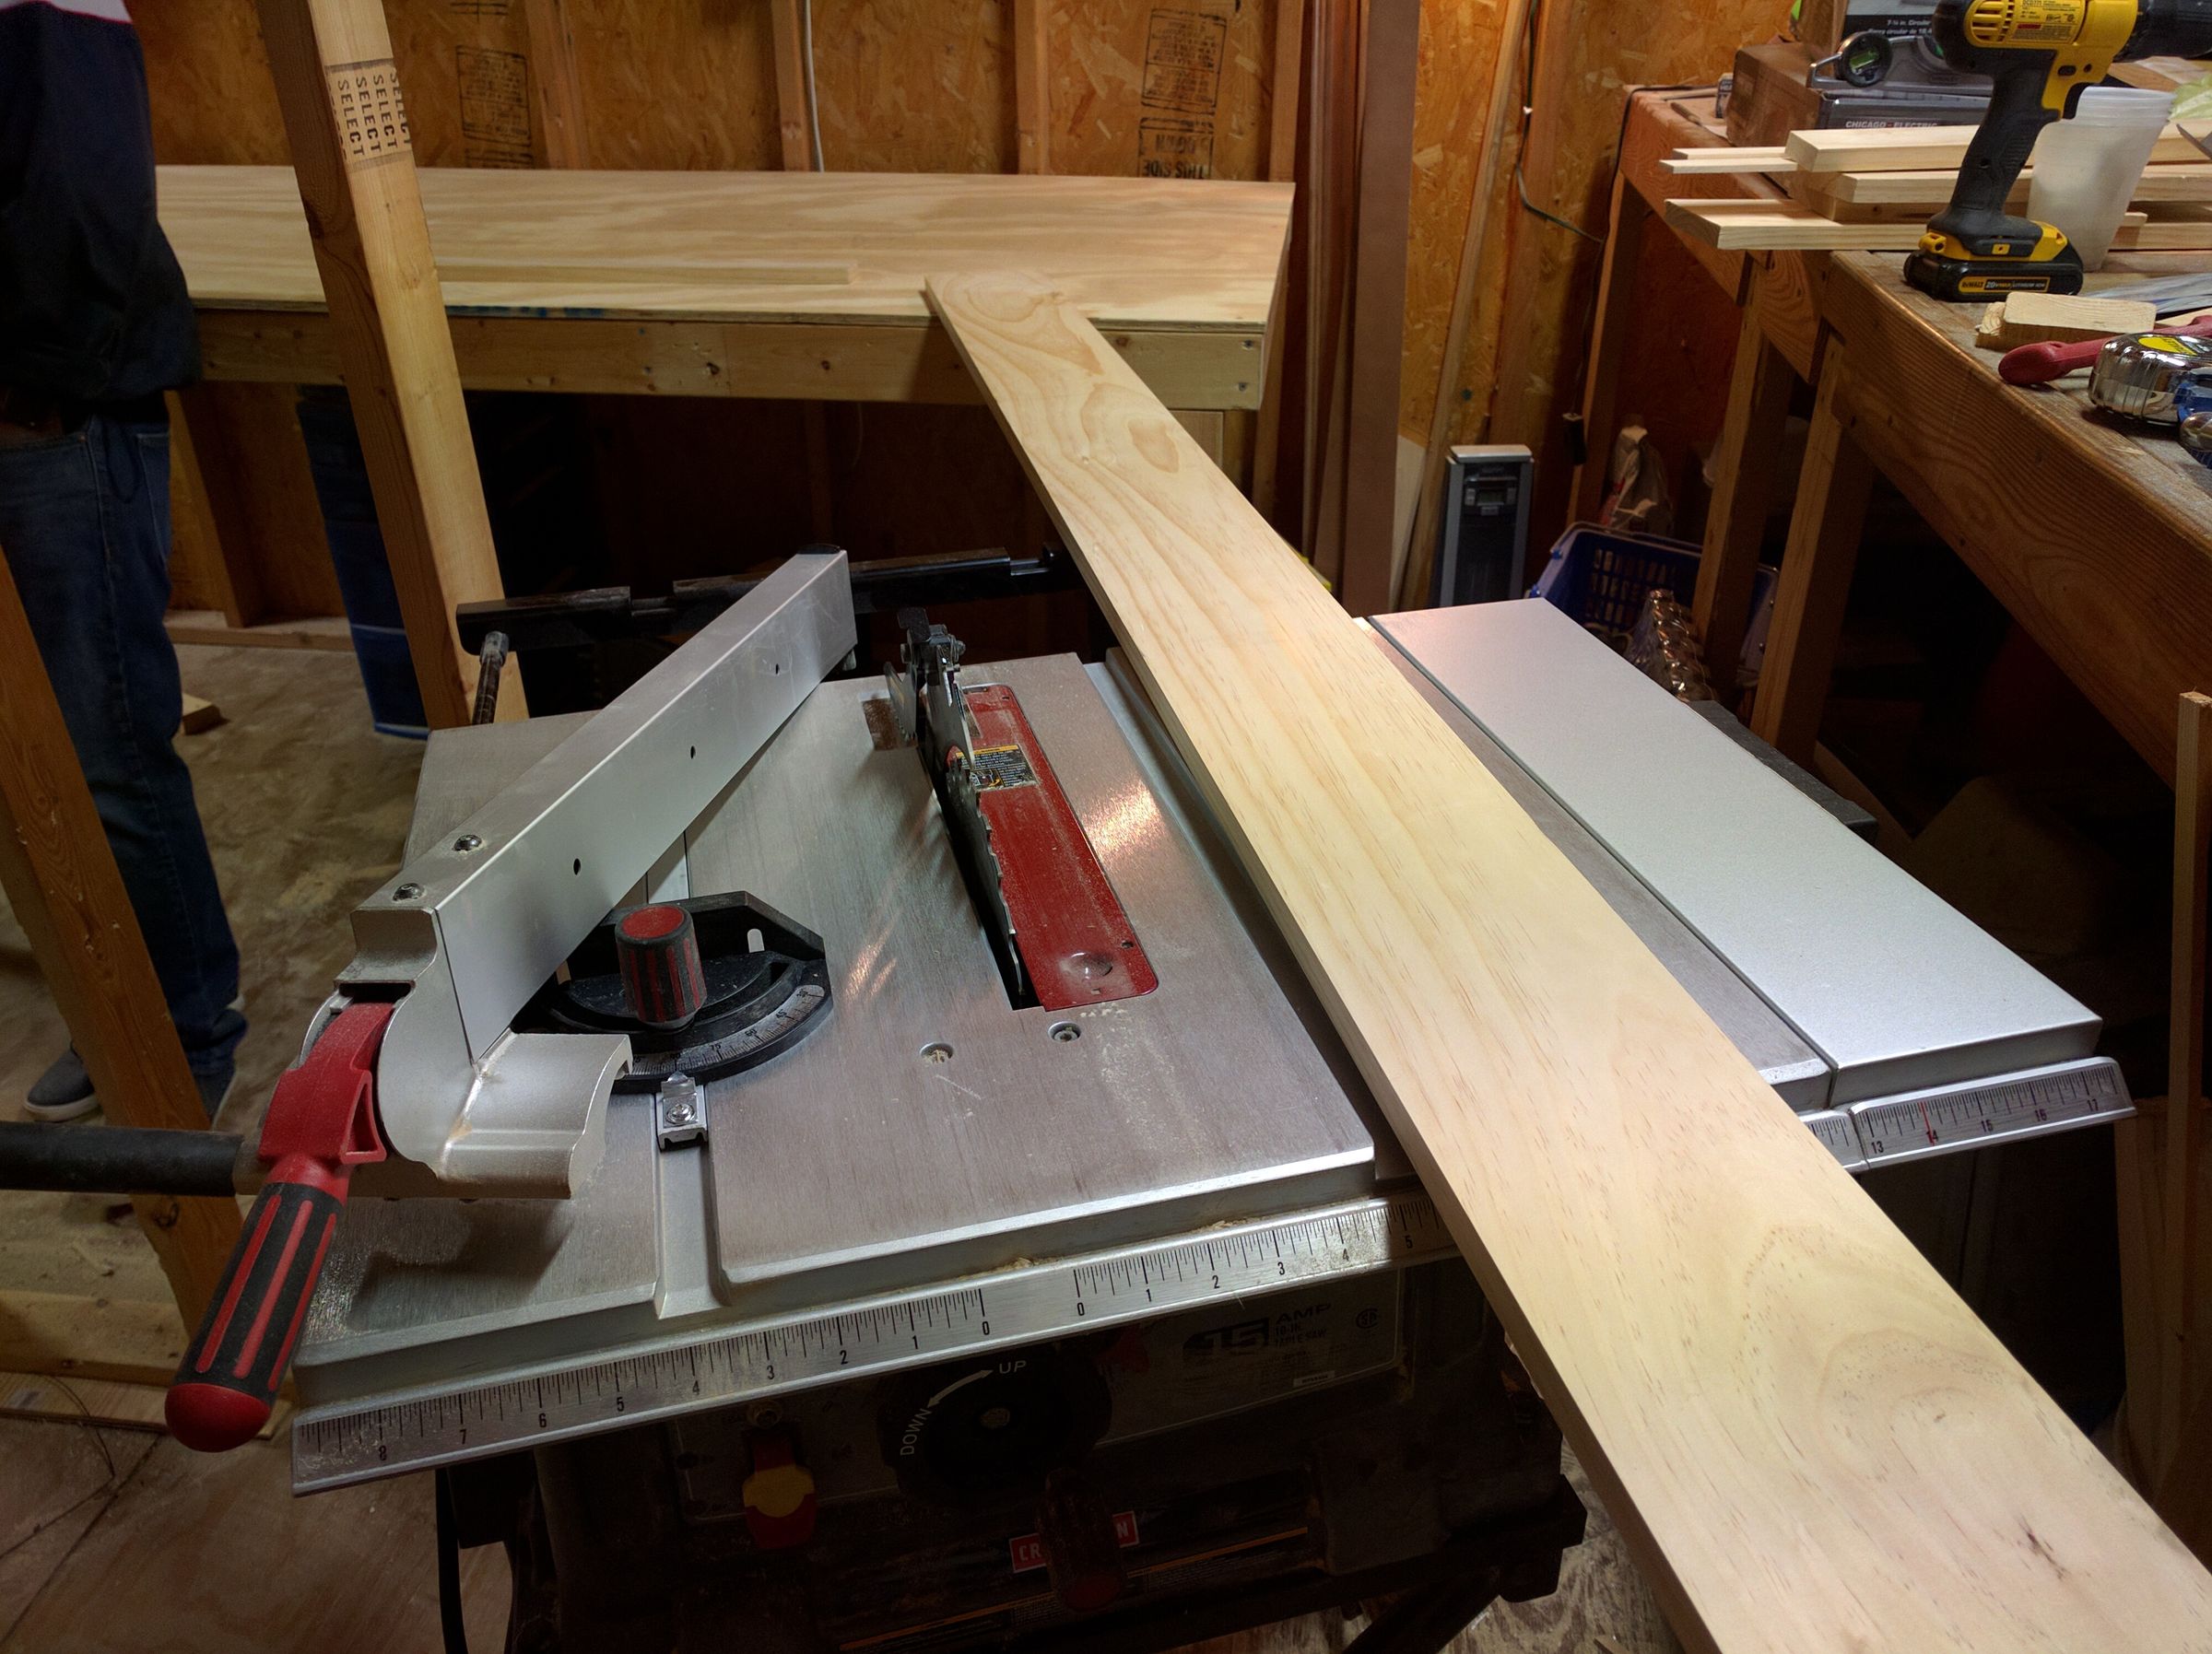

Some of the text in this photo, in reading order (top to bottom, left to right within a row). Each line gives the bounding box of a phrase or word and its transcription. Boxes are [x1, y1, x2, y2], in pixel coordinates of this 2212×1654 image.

[337, 79, 365, 156] SELECT
[356, 76, 382, 152] SELECT
[373, 74, 398, 148] SELECT
[711, 1041, 723, 1050] 75
[745, 1028, 757, 1037] 60
[1871, 1141, 1884, 1155] 13
[1982, 1120, 1994, 1132] 15
[2035, 1109, 2047, 1121] 16
[2087, 1098, 2099, 1111] 17
[1077, 1236, 1413, 1317] 0 1 2 3 4 5
[1276, 1303, 1332, 1324] AMP
[379, 1320, 990, 1460] 8 7 6 5 4 3 2 1 0
[999, 1361, 1027, 1374] UP
[900, 1408, 933, 1456] DOWN
